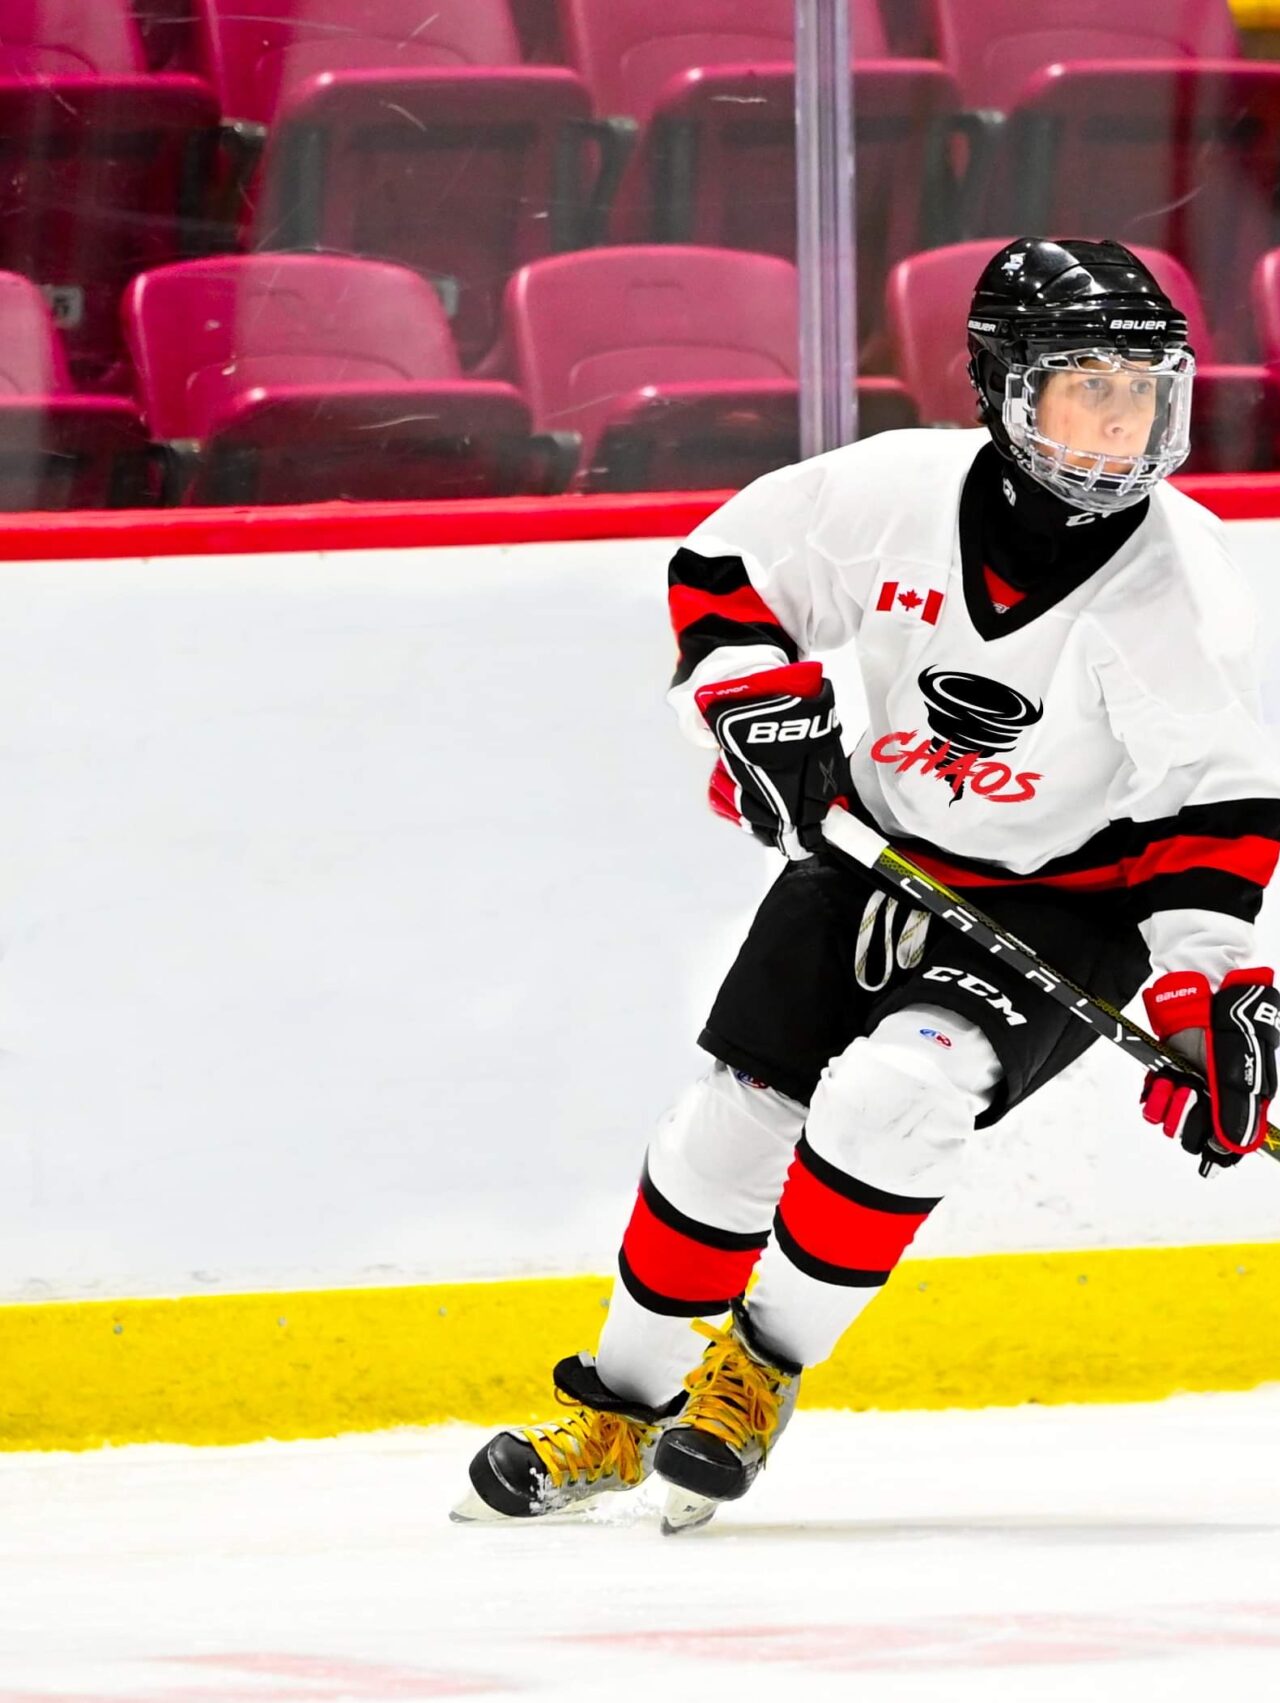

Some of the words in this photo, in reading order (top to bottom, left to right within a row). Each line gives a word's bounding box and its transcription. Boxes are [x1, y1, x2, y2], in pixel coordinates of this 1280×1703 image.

[1109, 318, 1168, 331] BAUER
[746, 708, 840, 744] BAU
[870, 729, 1046, 804] CHAOS
[900, 875, 1172, 1072] CATALY
[922, 966, 1028, 1027] CCM
[1155, 986, 1198, 1003] BAUER
